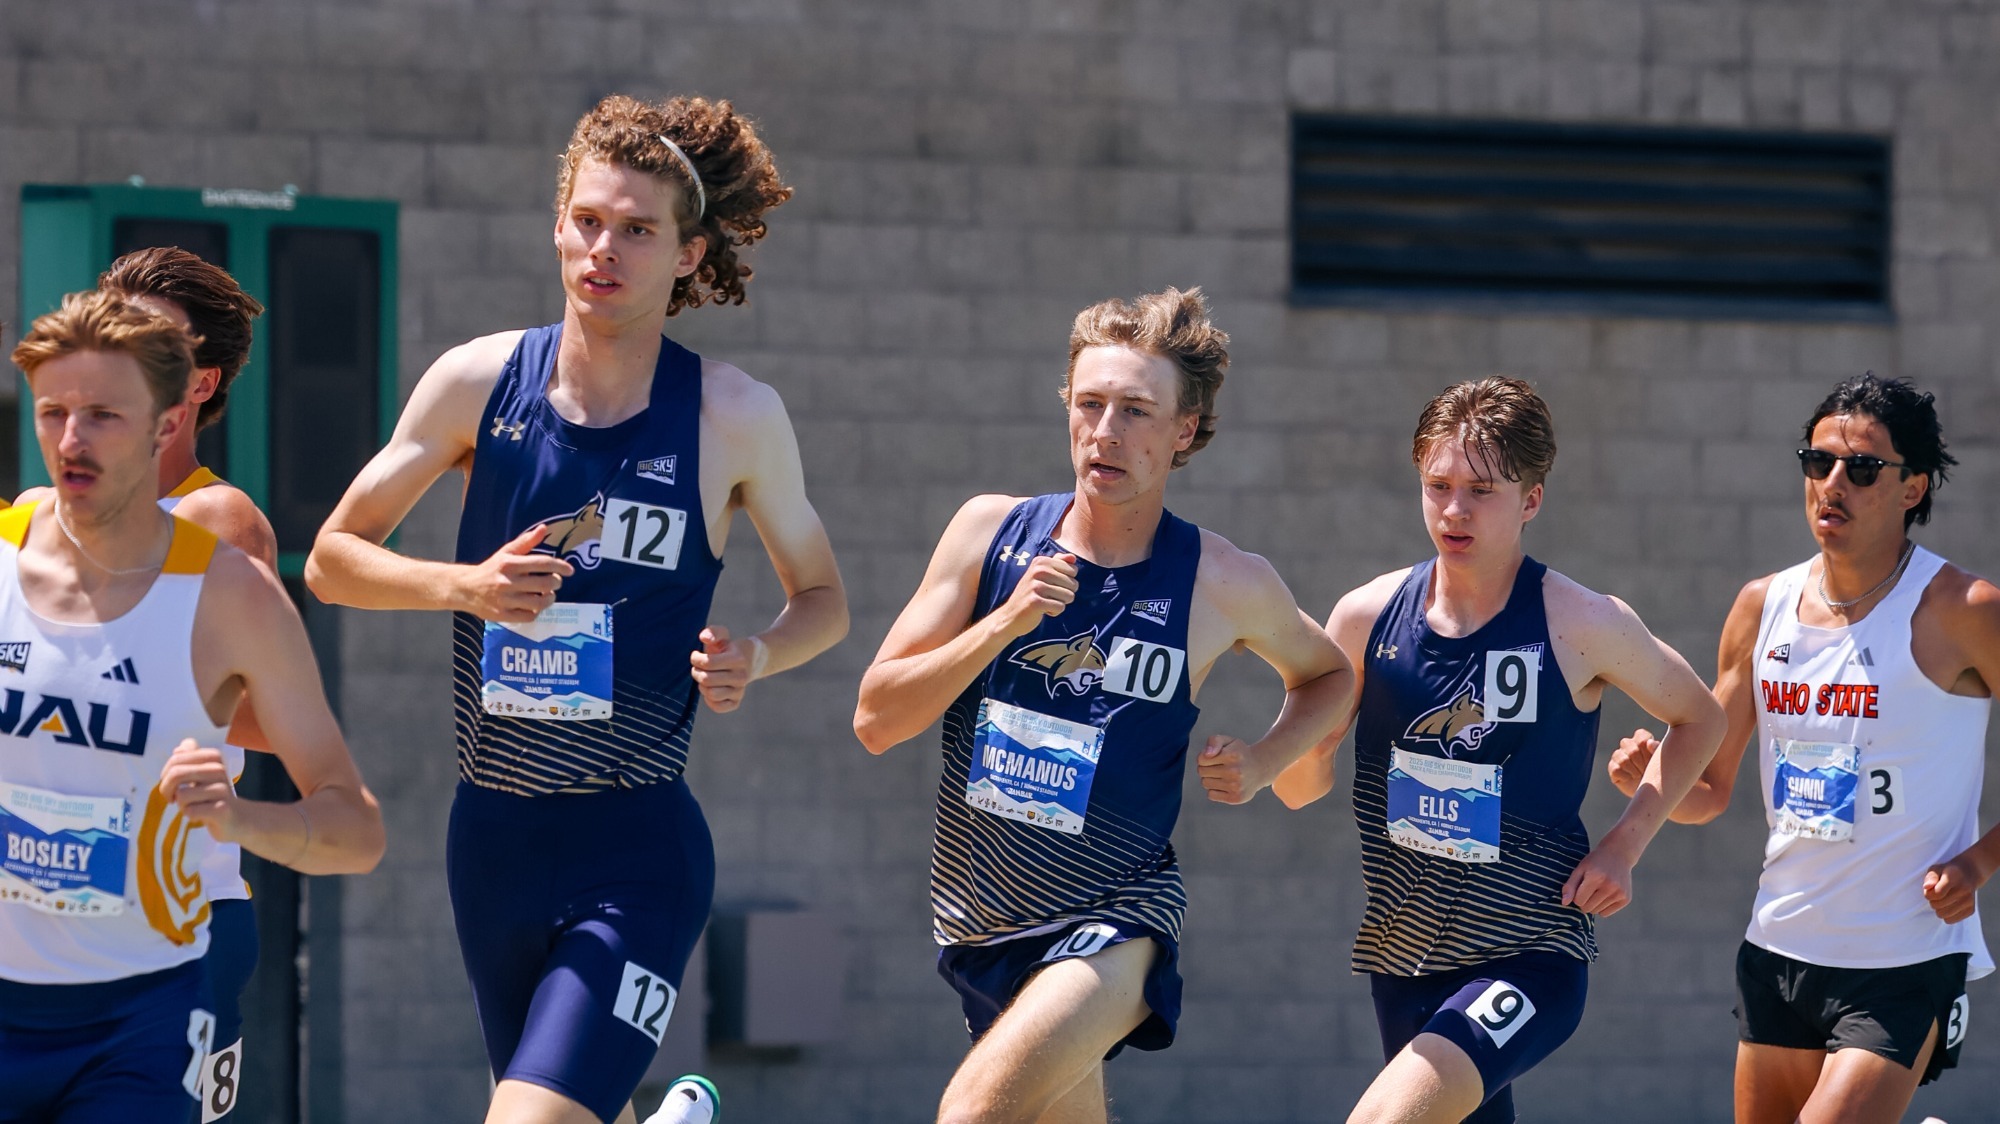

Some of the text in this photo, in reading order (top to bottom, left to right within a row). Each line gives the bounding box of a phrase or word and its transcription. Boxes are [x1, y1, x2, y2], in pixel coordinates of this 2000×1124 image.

[618, 506, 670, 565] 12
[0, 643, 29, 664] SKY
[501, 646, 578, 676] CRAMB
[1124, 643, 1171, 698] 10
[1496, 655, 1527, 719] 9
[1816, 683, 1879, 719] STATE
[982, 744, 1078, 791] MCMANUS
[1409, 757, 1423, 766] 2025
[1434, 761, 1446, 770] SKY
[1446, 764, 1473, 775] OUTDOOR
[1419, 795, 1460, 822] ELLS
[1870, 769, 1894, 815] 3
[7, 832, 92, 872] BOSLEY
[631, 974, 670, 1039] 12
[1478, 989, 1524, 1031] 9
[1948, 1001, 1962, 1046] 3
[212, 1051, 235, 1115] 8
